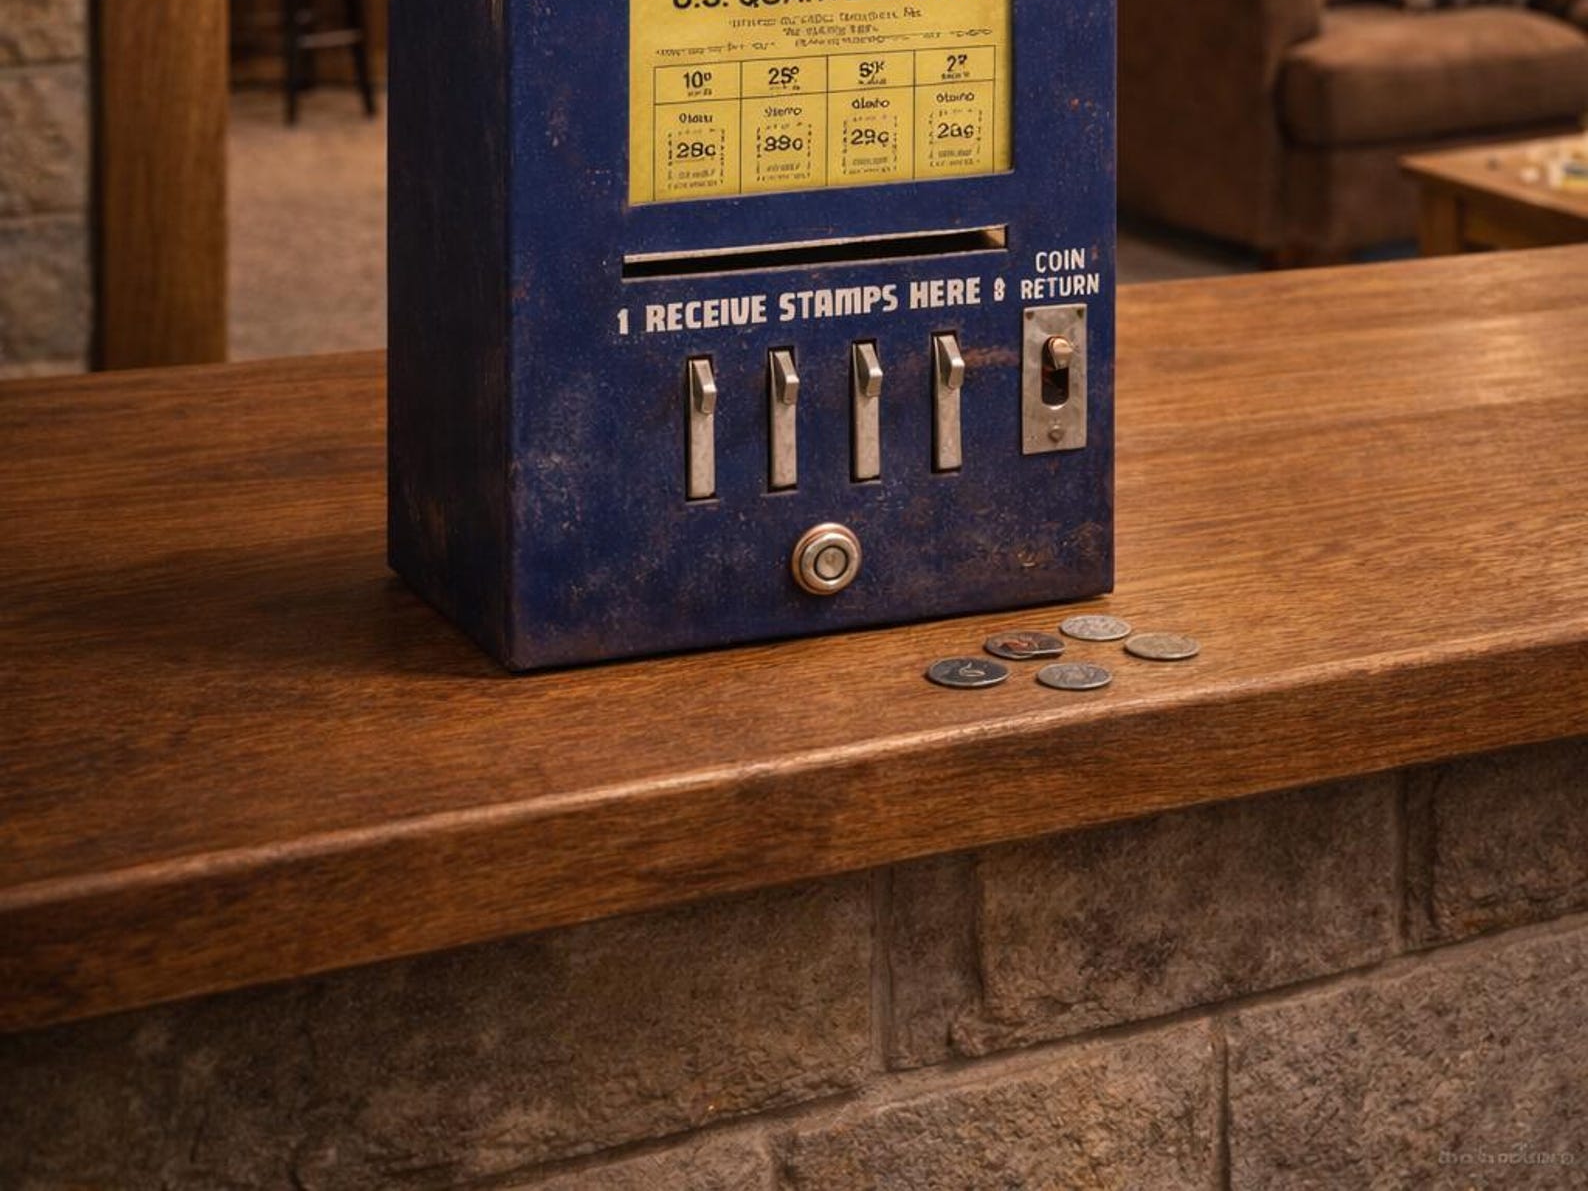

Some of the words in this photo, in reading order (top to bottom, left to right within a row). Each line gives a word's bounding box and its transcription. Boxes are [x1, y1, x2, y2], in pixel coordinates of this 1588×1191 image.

[1035, 247, 1086, 273] COIN
[1020, 273, 1100, 300] RETURN
[645, 293, 767, 333] RECEIVE
[779, 283, 898, 322] STAMPS
[909, 276, 981, 309] HERE
